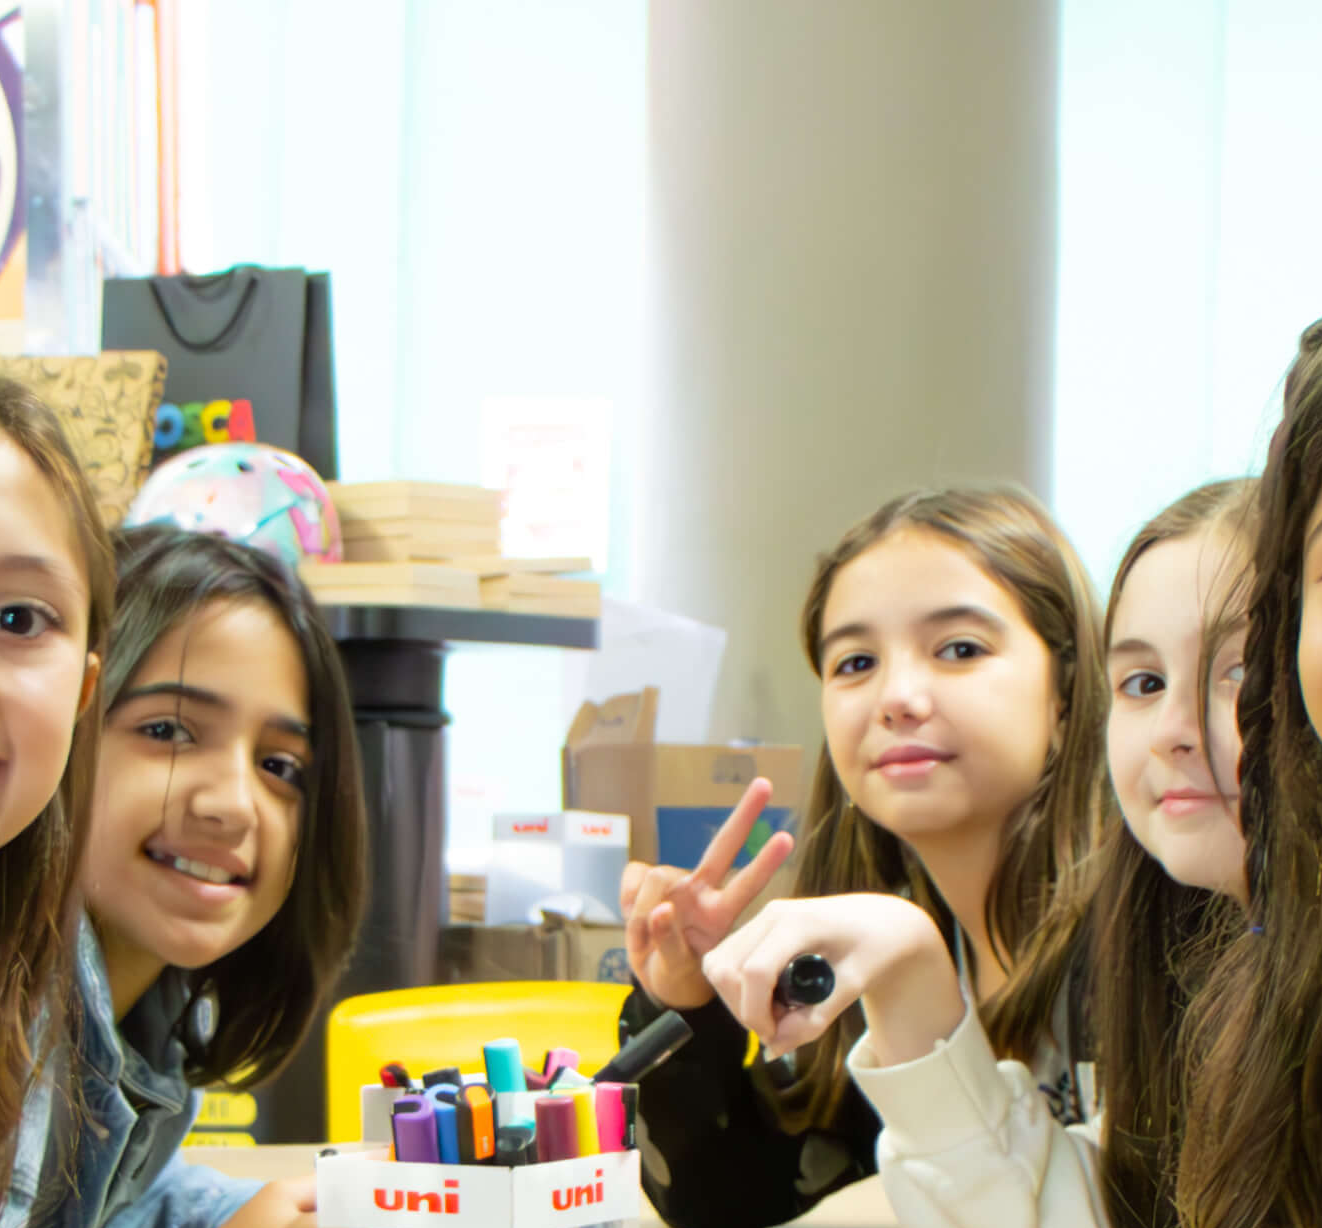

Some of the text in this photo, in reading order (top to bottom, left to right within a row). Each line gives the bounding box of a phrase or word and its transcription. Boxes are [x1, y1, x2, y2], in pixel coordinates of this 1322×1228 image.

[154, 398, 257, 449] OSCA
[374, 1179, 460, 1215] uni
[551, 1168, 604, 1211] uni
